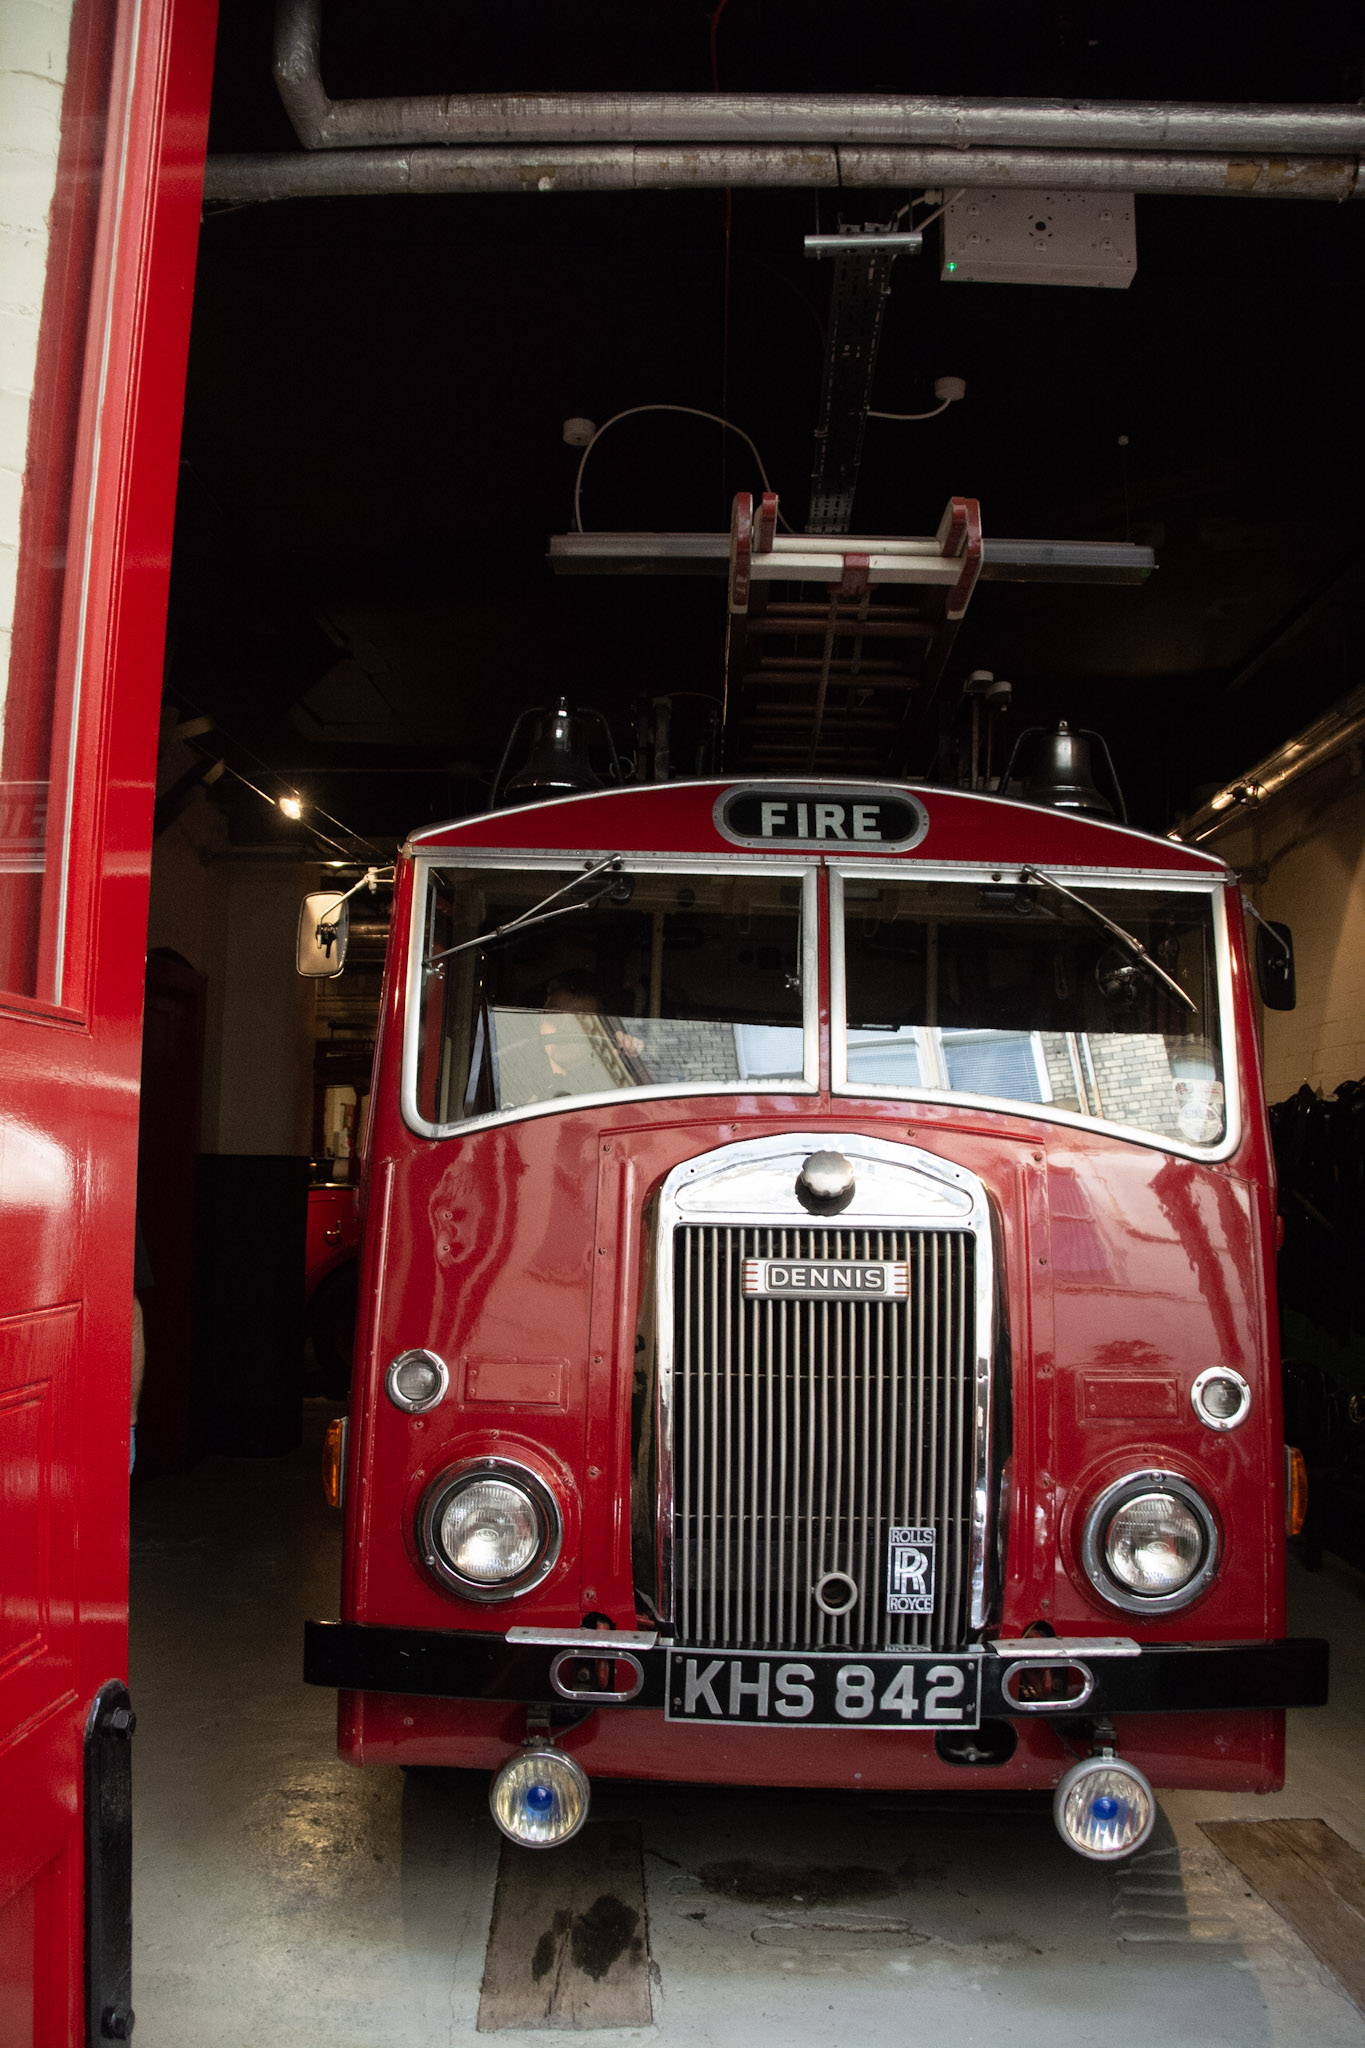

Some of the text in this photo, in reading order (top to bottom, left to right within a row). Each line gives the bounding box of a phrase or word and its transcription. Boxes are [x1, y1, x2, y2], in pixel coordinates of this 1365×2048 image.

[761, 801, 882, 840] FIRE
[771, 1267, 882, 1288] DENNIS
[892, 1530, 933, 1543] ROLLS
[890, 1597, 931, 1610] ROYCE
[684, 1659, 965, 1720] KHS 842
